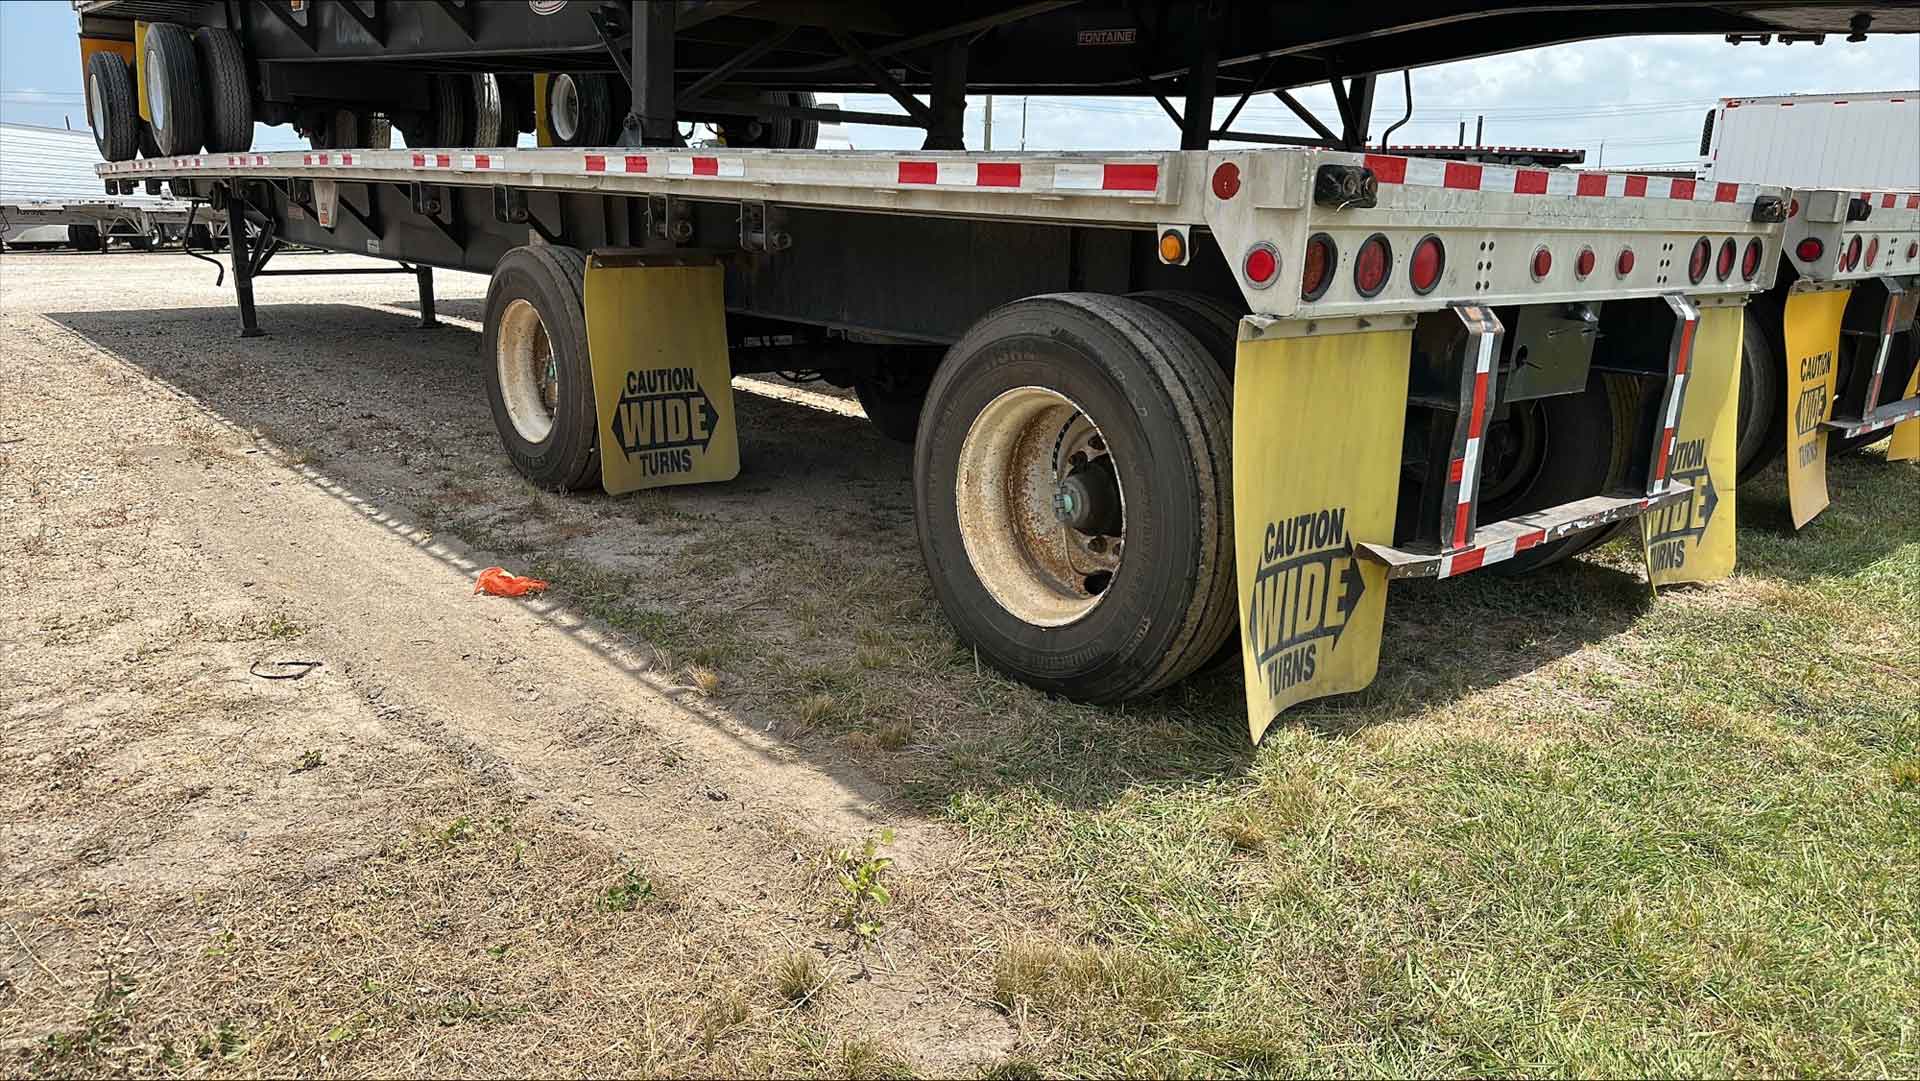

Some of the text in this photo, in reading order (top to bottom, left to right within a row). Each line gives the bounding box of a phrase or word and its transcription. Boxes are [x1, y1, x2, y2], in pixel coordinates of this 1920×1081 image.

[1079, 31, 1133, 42] FONTAINE
[626, 368, 694, 395] CAUTION
[1800, 351, 1832, 382] CAUTION
[620, 397, 709, 449] WIDE
[1799, 386, 1825, 434] WIDE
[640, 448, 692, 477] TURNS
[1799, 441, 1818, 468] TURNS
[1264, 508, 1346, 564] CAUTION
[1255, 556, 1353, 657] WIDE
[1267, 643, 1316, 699] TURNS
